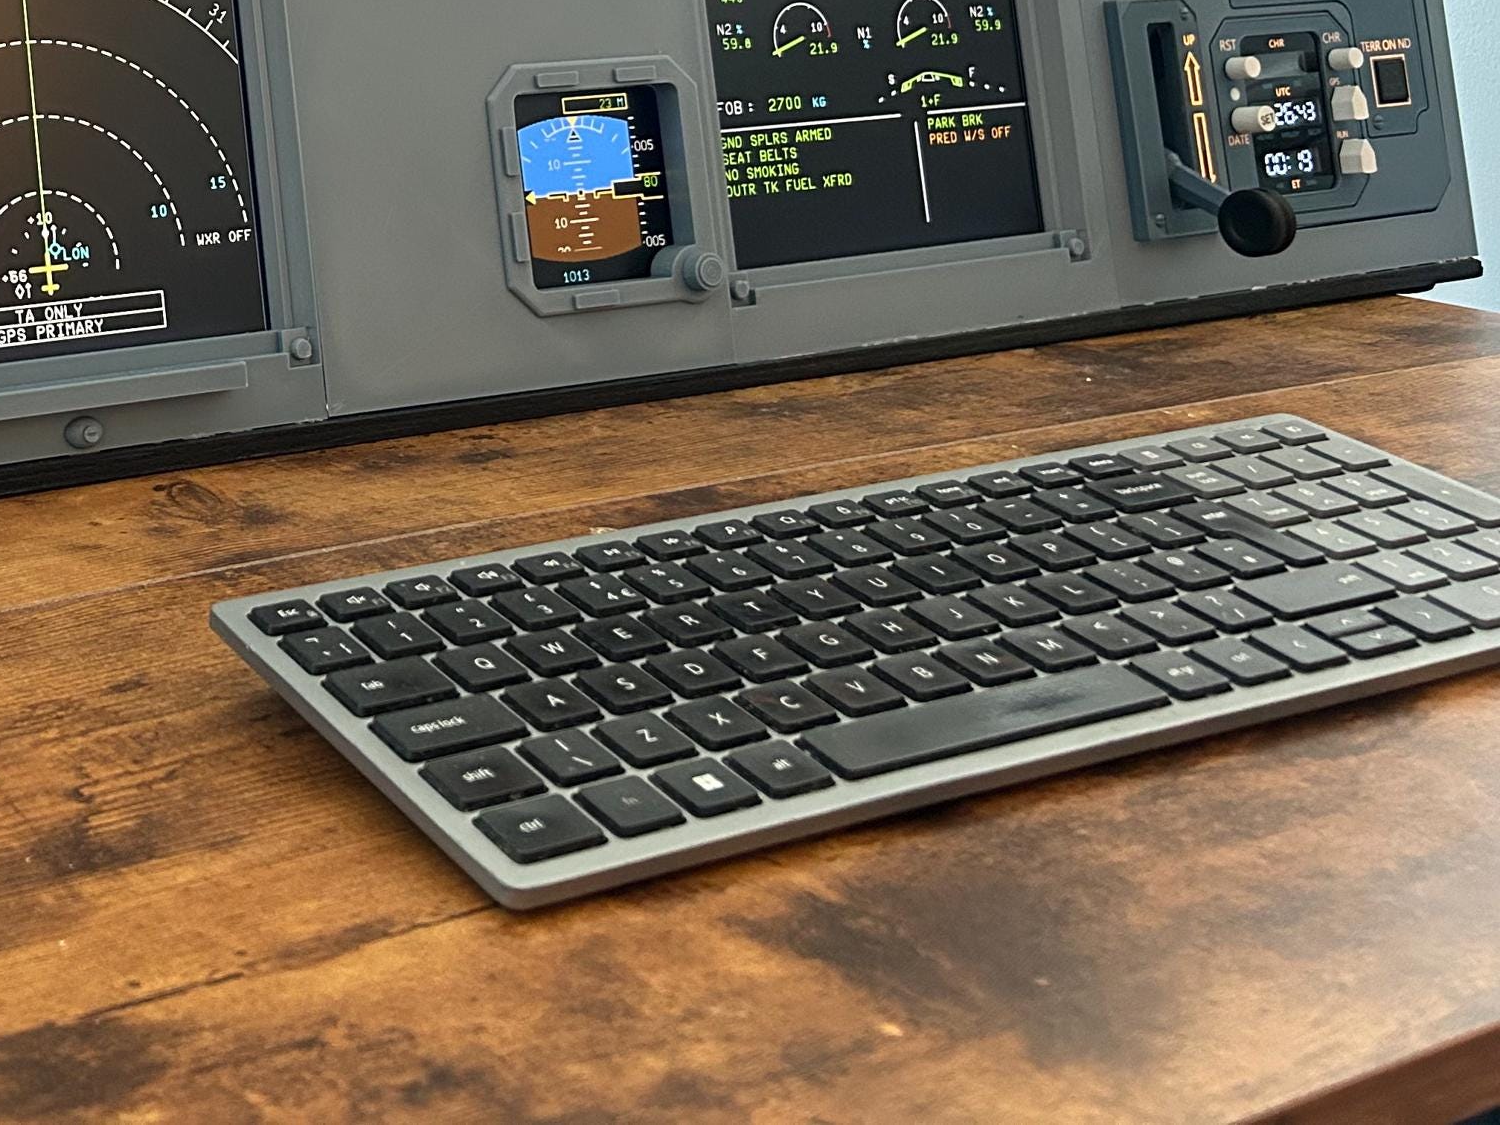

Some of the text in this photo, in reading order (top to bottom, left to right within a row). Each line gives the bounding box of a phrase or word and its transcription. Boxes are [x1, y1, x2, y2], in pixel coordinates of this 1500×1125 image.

[209, 3, 227, 24] 31
[970, 5, 983, 18] N2
[717, 24, 732, 36] N2
[975, 19, 1001, 31] 59.9
[857, 26, 872, 39] N1
[1322, 32, 1341, 43] CHR
[931, 33, 958, 46] 21.9
[1183, 34, 1195, 46] UP
[1220, 40, 1236, 51] RST
[1269, 39, 1284, 48] CHR
[1361, 39, 1411, 52] TERR ON ND
[809, 42, 838, 55] 21.9
[1275, 86, 1291, 97] UTC
[768, 96, 801, 112] 2700
[812, 97, 826, 108] KG
[927, 114, 983, 129] PARK BRK
[1261, 113, 1274, 125] SET
[721, 128, 831, 150] GND SPLRS ARMED
[929, 126, 1011, 144] PRED W/S OFF
[1228, 134, 1250, 146] DATE
[723, 147, 797, 165] SEAT BELTS
[725, 163, 799, 181] NO SMOKING
[210, 176, 226, 189] 15
[727, 173, 852, 197] OUTR TK FUEL XFRD
[1292, 180, 1301, 189] ET
[150, 205, 167, 218] 10
[555, 218, 568, 229] 10
[196, 229, 251, 245] WXR OFF
[64, 246, 89, 261] LON
[564, 269, 590, 283] 1013
[15, 303, 83, 324] TA ONLY
[37, 320, 104, 340] PRIMARY
[1004, 596, 1024, 607] K
[679, 615, 700, 625] R
[613, 627, 632, 640] E
[881, 622, 903, 633] H
[820, 635, 839, 645] G
[541, 642, 564, 655] W
[684, 663, 704, 675] D
[361, 680, 384, 691] tab
[617, 677, 635, 691] S
[547, 694, 566, 707] A
[780, 696, 800, 709] C
[708, 712, 730, 725] X
[462, 767, 495, 781] shift
